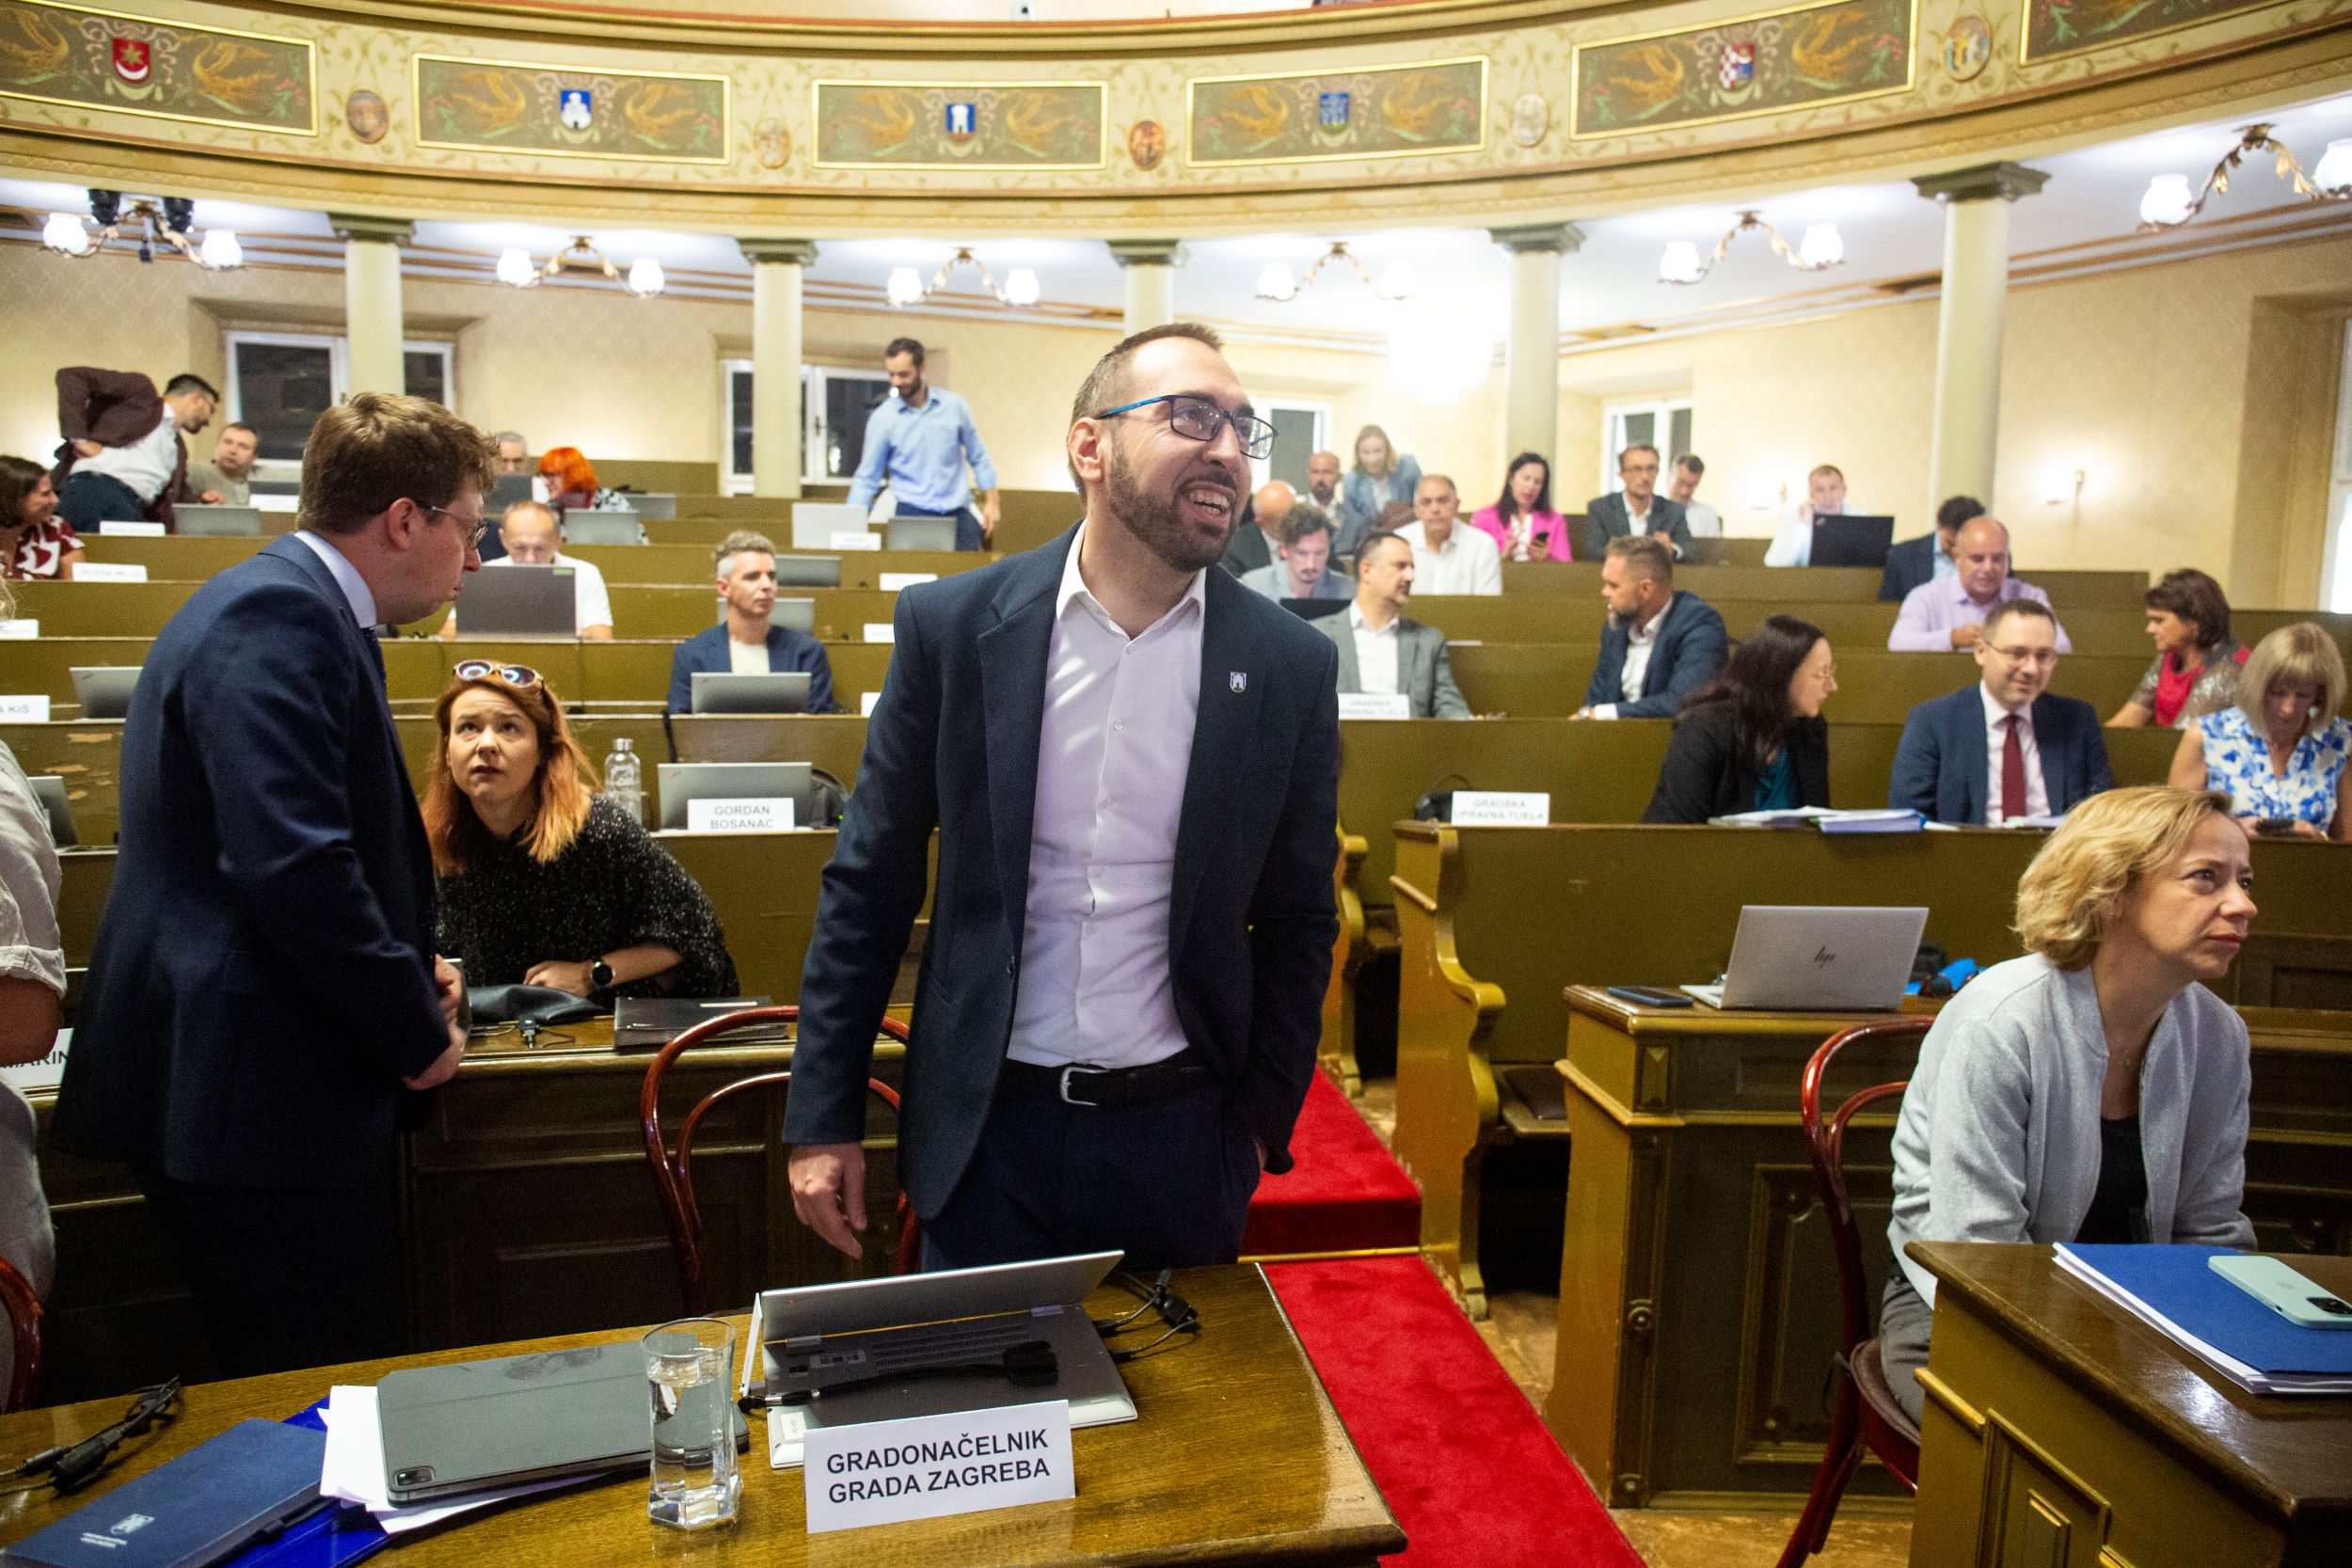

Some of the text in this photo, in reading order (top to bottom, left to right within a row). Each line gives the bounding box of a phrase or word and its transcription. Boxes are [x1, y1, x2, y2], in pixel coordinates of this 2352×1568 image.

[710, 818, 774, 829] BOSANAC
[714, 805, 771, 816] GORDAN
[827, 1428, 1049, 1474] GRADONAČELNIK
[829, 1457, 1050, 1504] GRADA ZAGREBA
